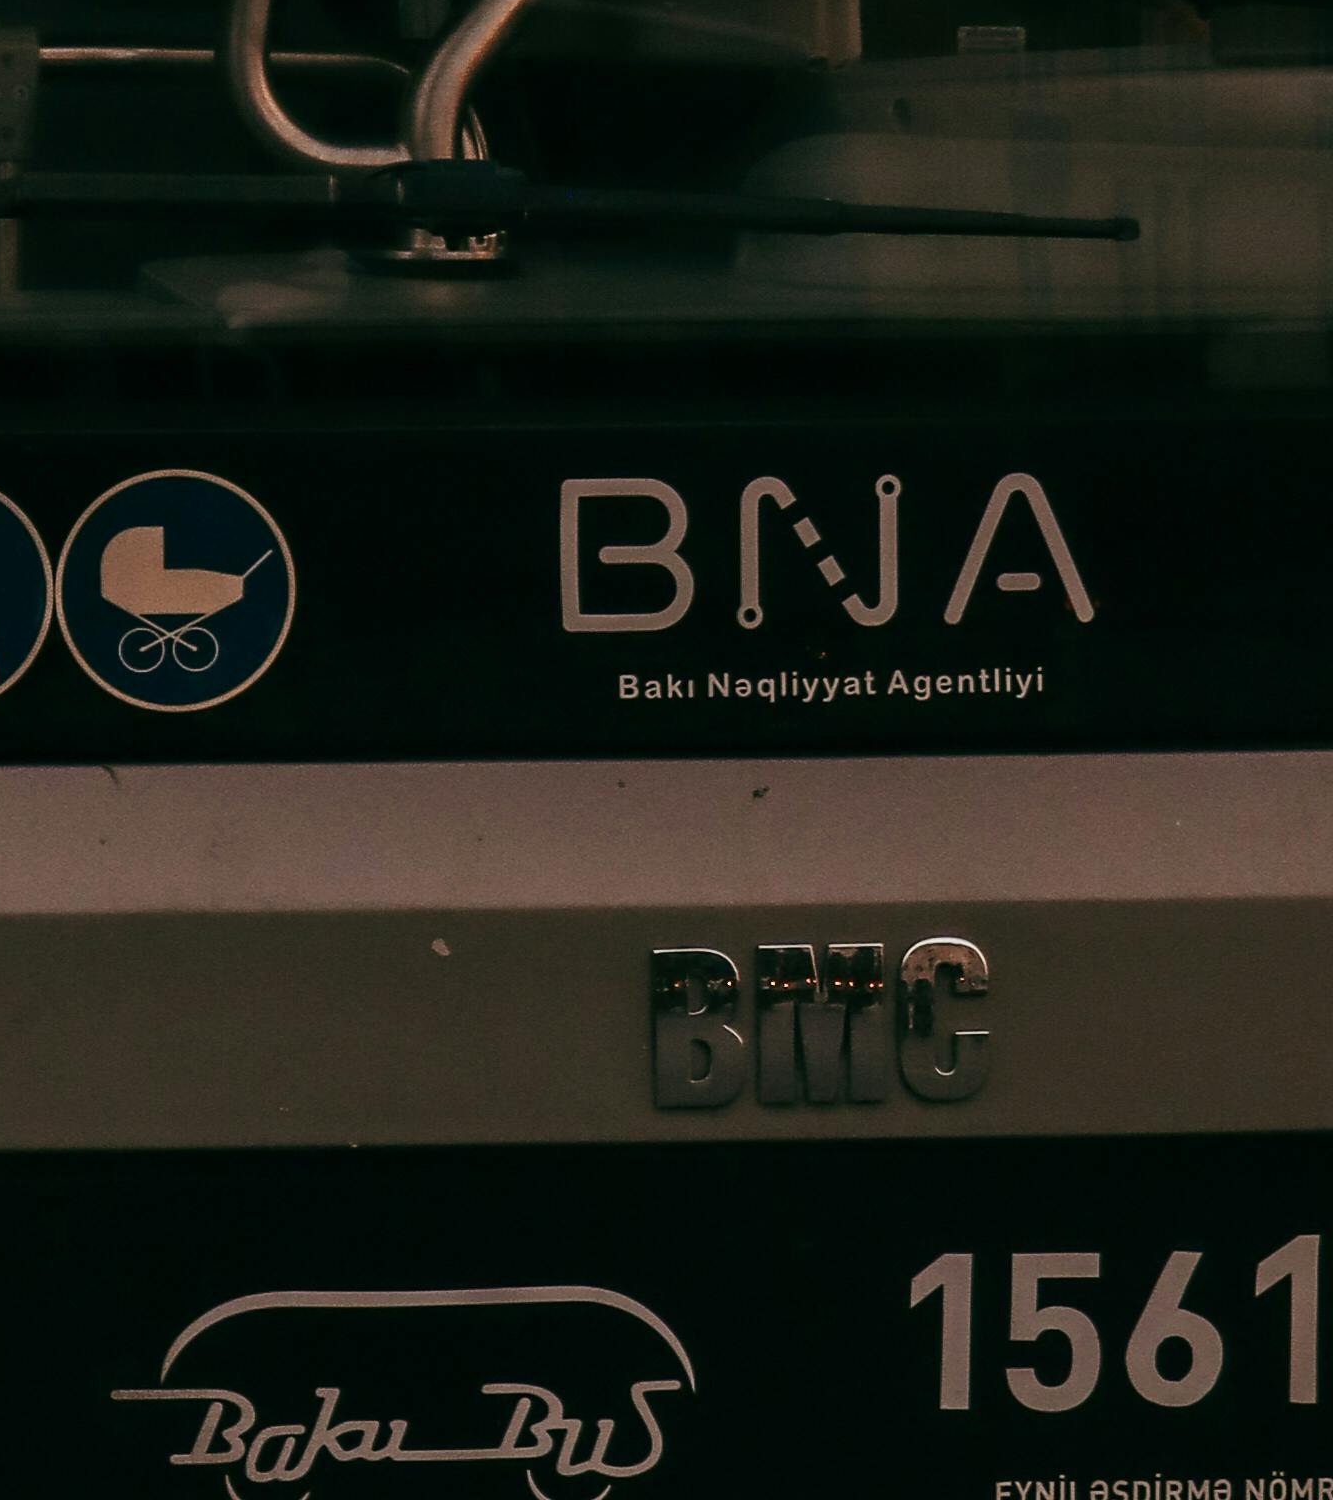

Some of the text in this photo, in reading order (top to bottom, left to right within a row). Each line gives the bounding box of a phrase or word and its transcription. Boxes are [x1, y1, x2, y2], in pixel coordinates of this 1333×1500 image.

[560, 472, 1096, 633] BNA
[708, 671, 876, 703] Nəqliyyat
[887, 667, 1044, 701] Agentliyi
[650, 936, 990, 1108] BMC
[910, 1234, 1320, 1412] 1561
[111, 1388, 411, 1483] Baku
